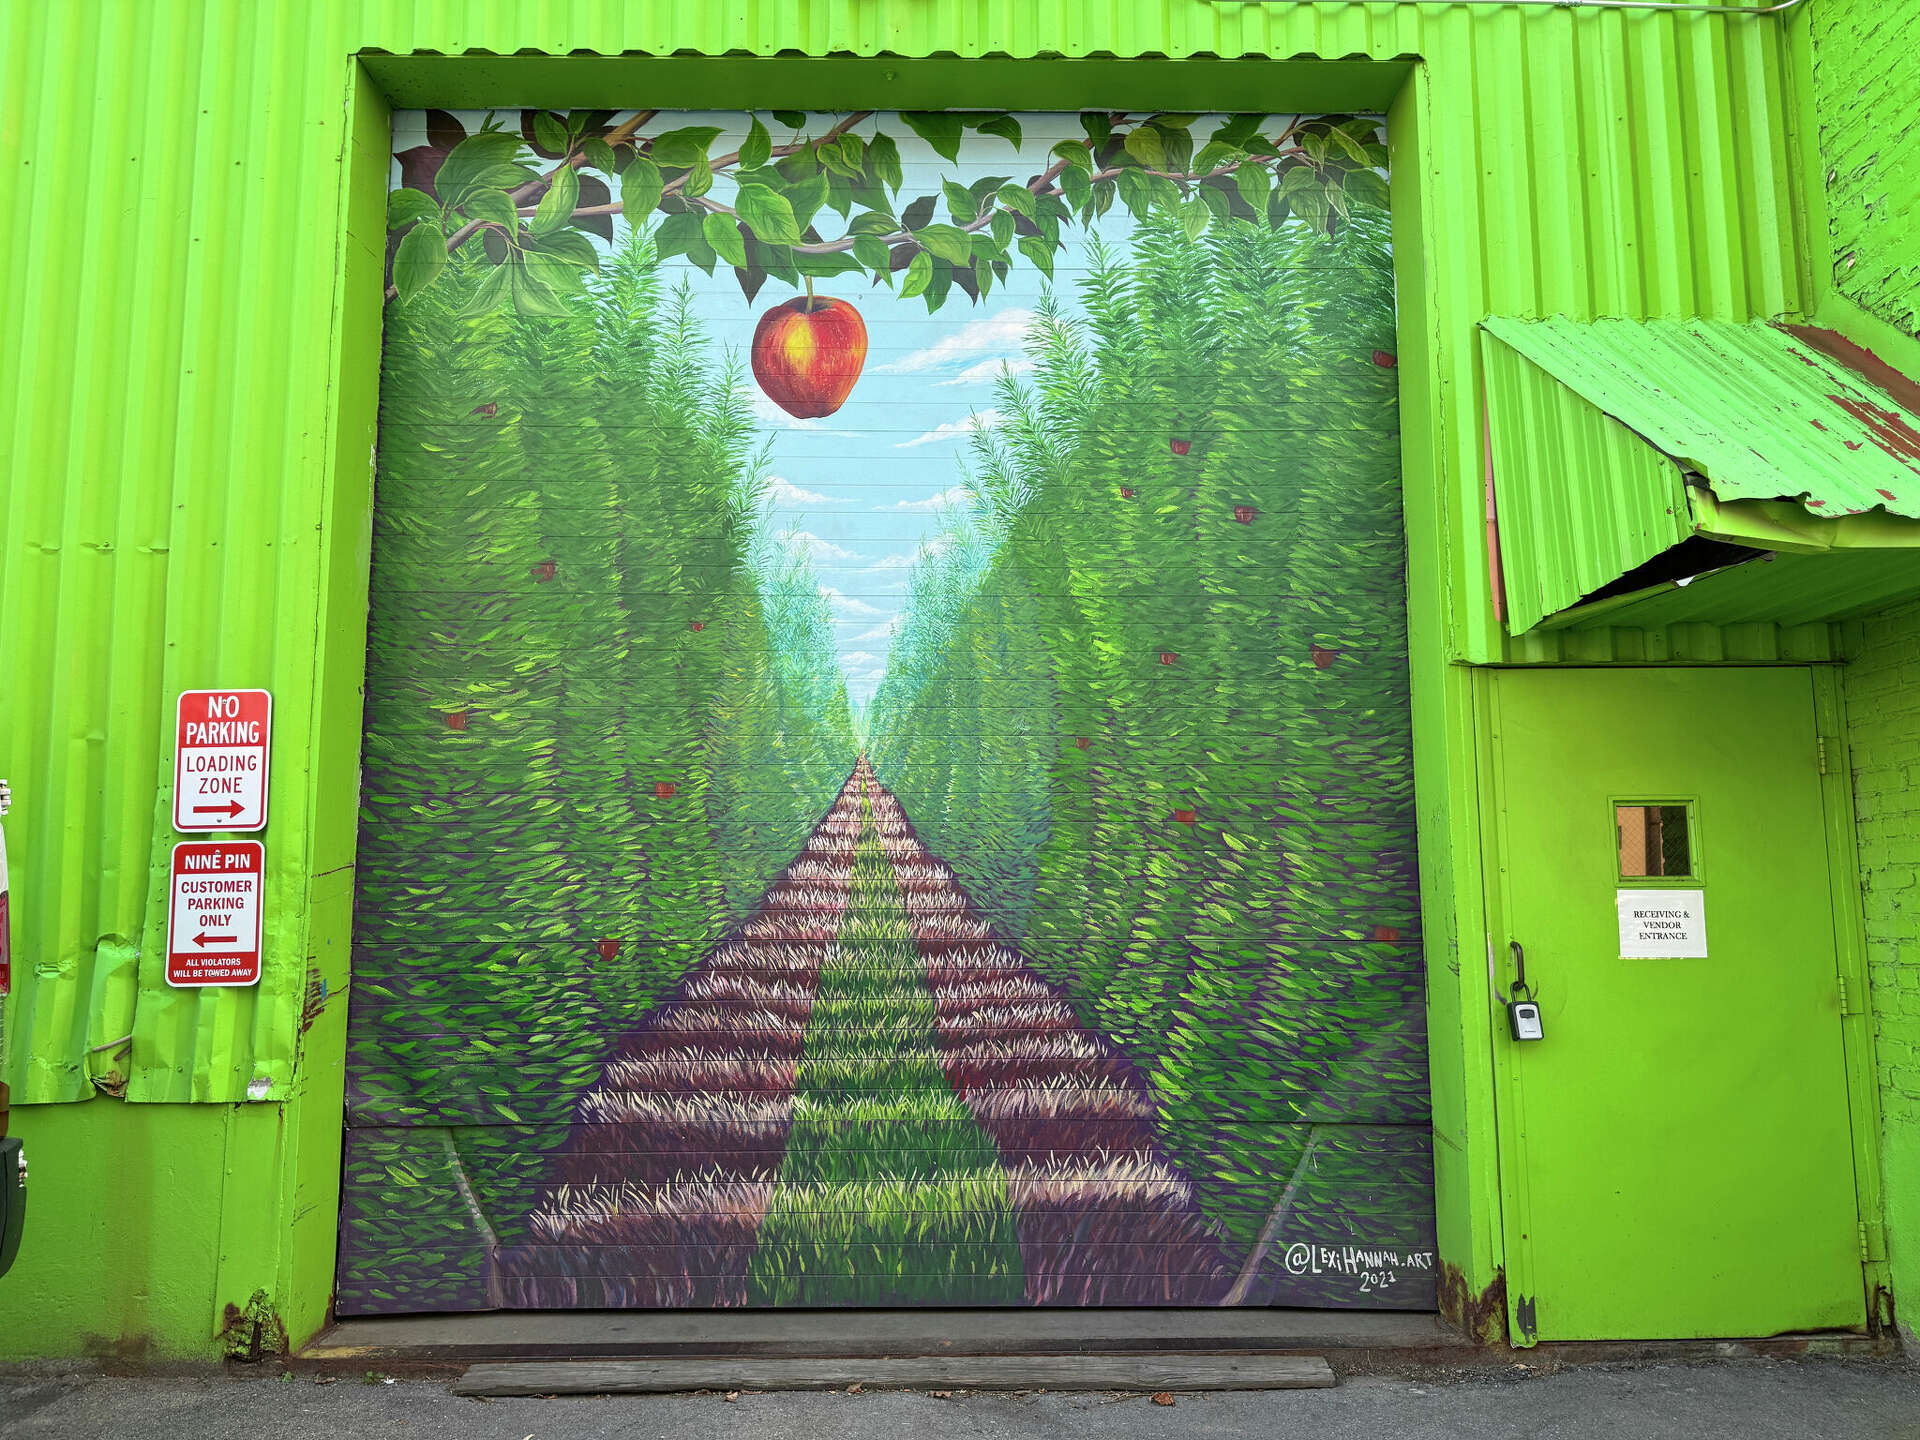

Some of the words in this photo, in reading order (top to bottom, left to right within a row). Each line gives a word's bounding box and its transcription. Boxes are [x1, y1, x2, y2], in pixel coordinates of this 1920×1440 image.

[208, 695, 240, 718] NO
[186, 721, 260, 744] PARKING
[186, 755, 257, 772] LOADING
[199, 777, 242, 794] ZONE
[184, 854, 221, 870] NINE
[224, 853, 251, 868] PIN
[181, 880, 252, 893] CUSTOMER
[187, 897, 245, 910] PARKING
[199, 914, 232, 927] ONLY
[1633, 910, 1682, 918] RECEIVING
[1683, 910, 1690, 918] &
[1643, 921, 1682, 929] VENDOR
[1639, 932, 1688, 940] ENTRANCE
[186, 959, 199, 967] ALL
[201, 958, 241, 967] VIOLATORS
[173, 970, 190, 978] WILL
[204, 969, 230, 977] TOWED
[231, 968, 252, 977] AWAY
[1359, 1271, 1396, 1292] 2021
